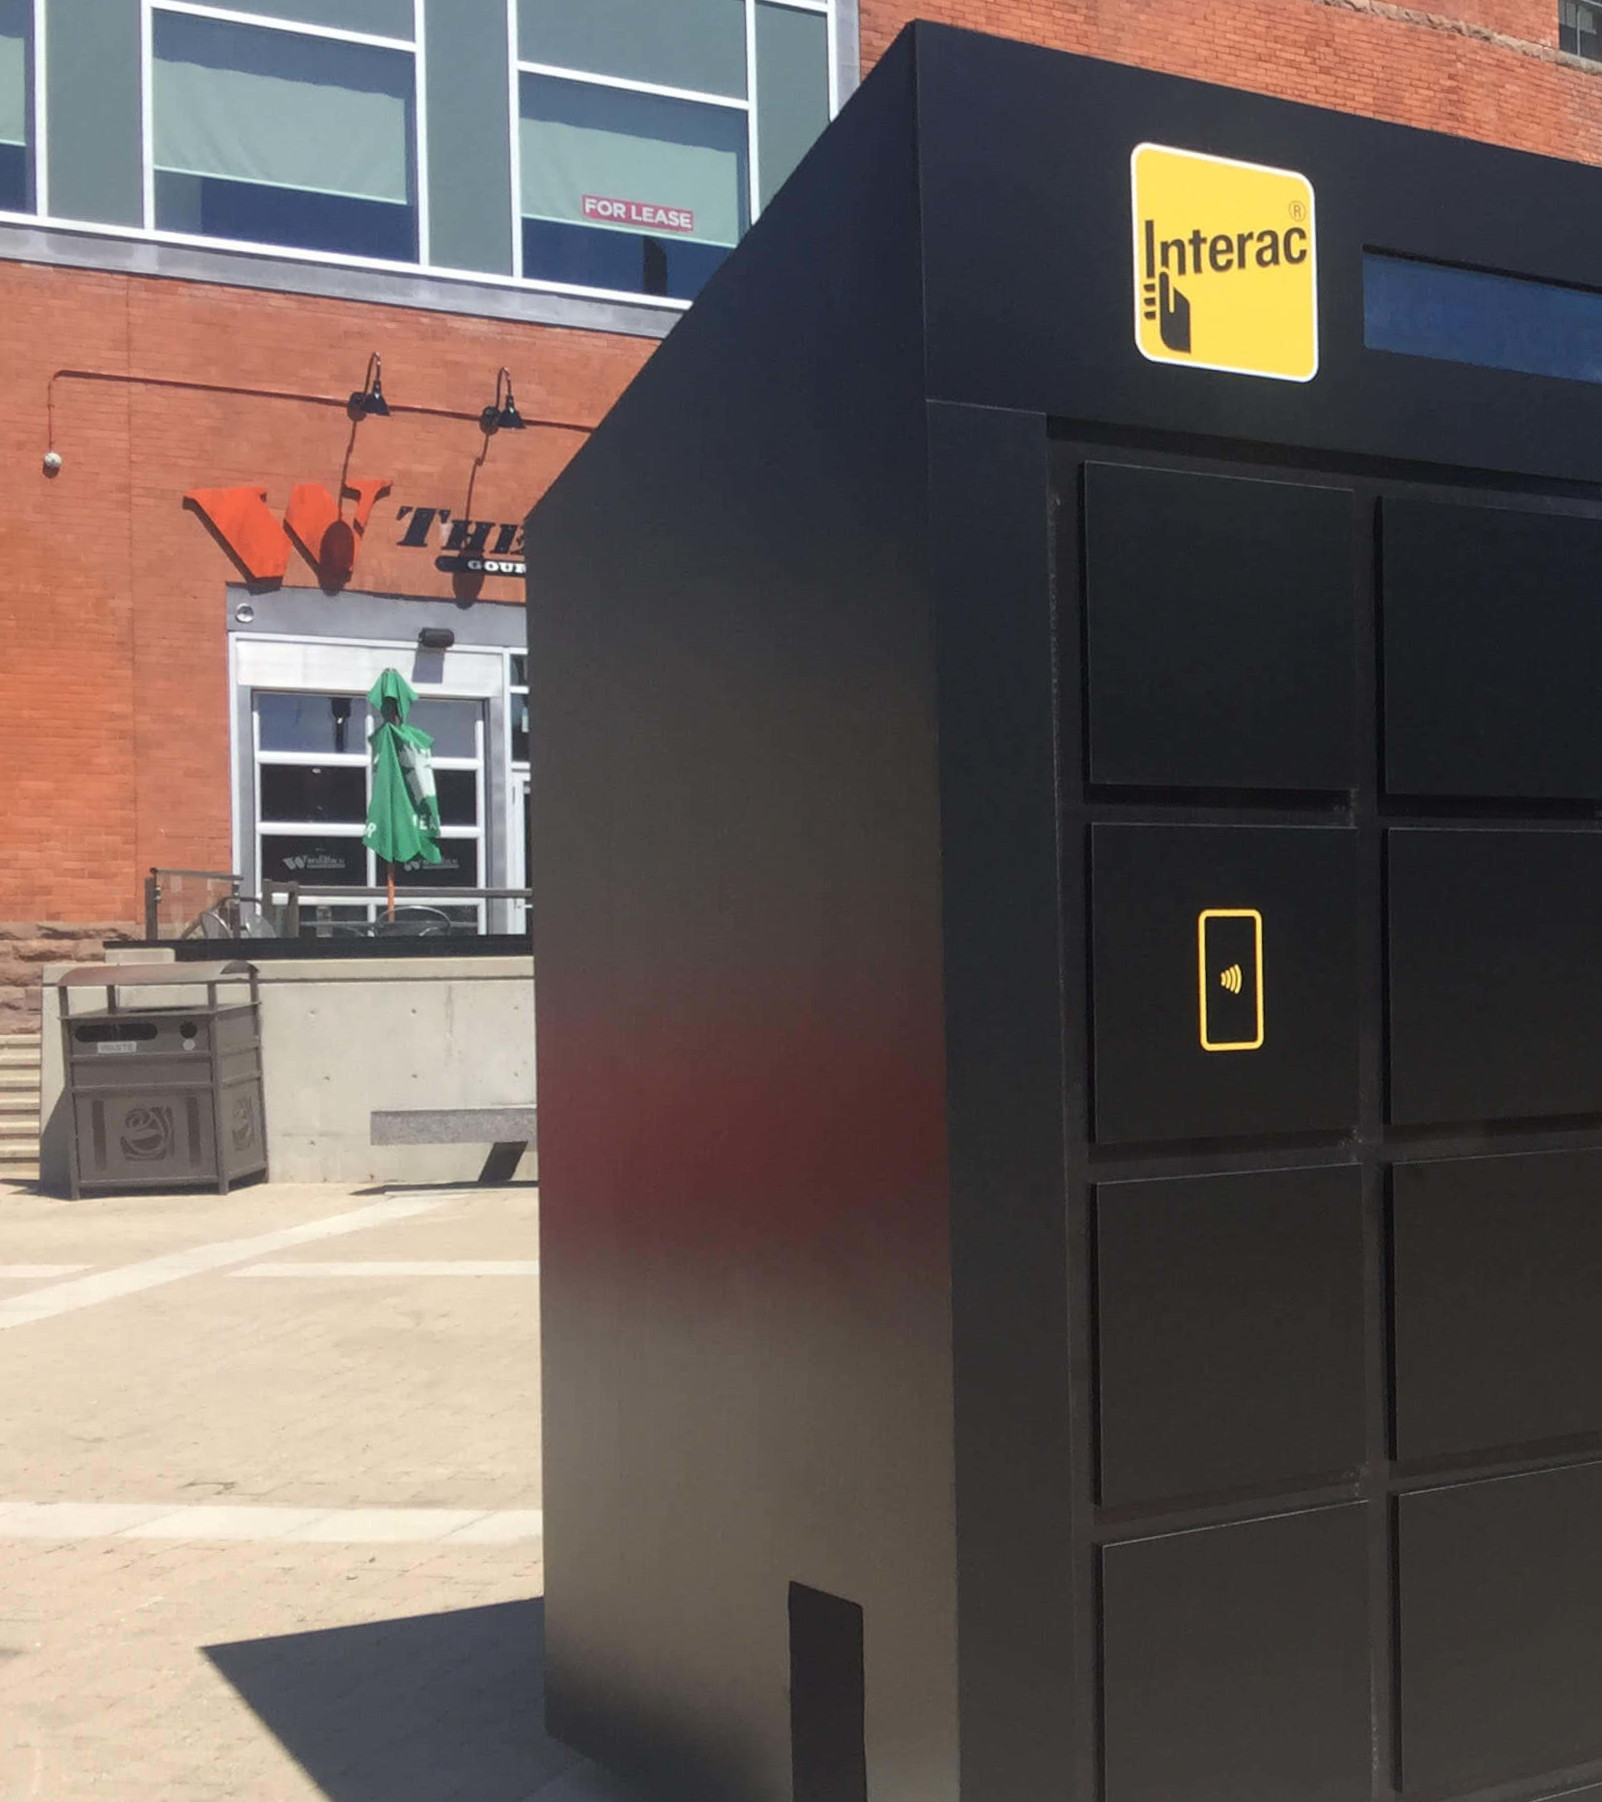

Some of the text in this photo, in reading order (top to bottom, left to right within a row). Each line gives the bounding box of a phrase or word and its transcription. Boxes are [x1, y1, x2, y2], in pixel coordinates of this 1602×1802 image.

[584, 198, 693, 229] FOR LEASE
[1144, 219, 1307, 279] Interac
